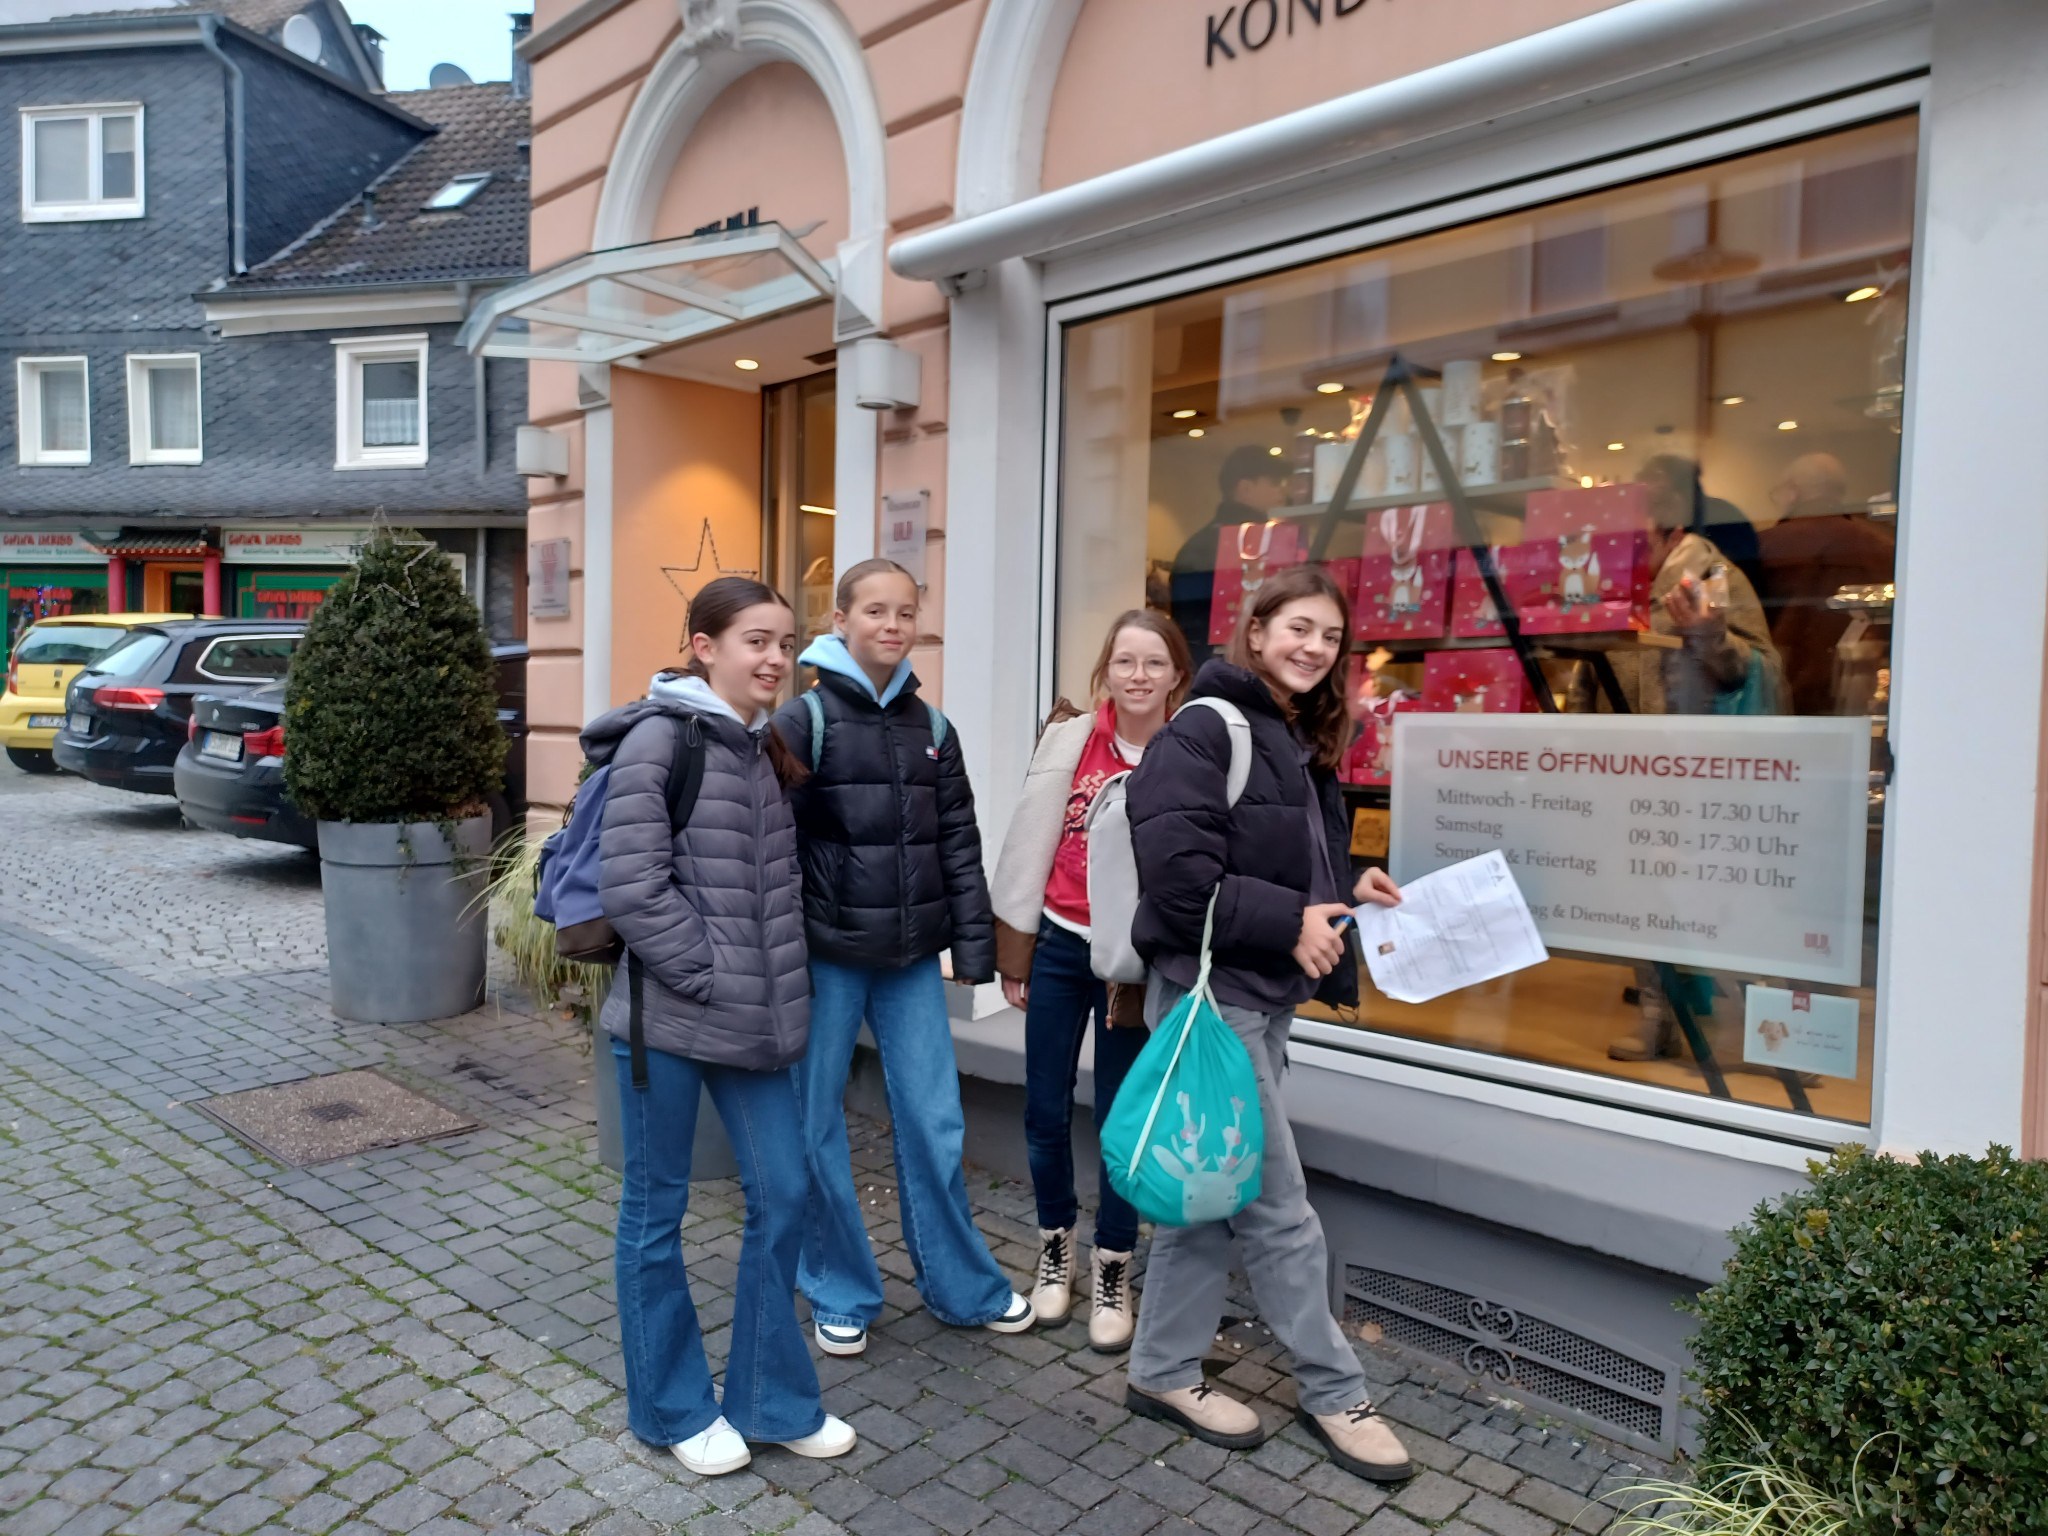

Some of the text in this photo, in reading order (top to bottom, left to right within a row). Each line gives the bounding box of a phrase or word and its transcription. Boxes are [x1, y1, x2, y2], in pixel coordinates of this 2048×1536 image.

[1437, 746, 1801, 782] UNSERE ÖFFNUNGSZEITEN:
[1436, 788, 1515, 808] Mittwoch
[1531, 793, 1593, 818] Freitag
[1629, 798, 1680, 818] 09.30
[1700, 802, 1751, 822] 17.30
[1758, 804, 1800, 824] Uhr
[1435, 814, 1504, 839] Samstag
[1628, 828, 1679, 848] 09.30
[1699, 833, 1750, 853] 17.30
[1757, 836, 1799, 856] Uhr
[1505, 848, 1520, 864] &
[1526, 849, 1597, 877] Feiertag
[1629, 859, 1677, 878] 11.00
[1697, 864, 1748, 884] 17.30
[1754, 868, 1796, 888] Uhr
[1552, 903, 1565, 919] &
[1570, 904, 1641, 931] Dienstag
[1646, 912, 1719, 939] Ruhetag
